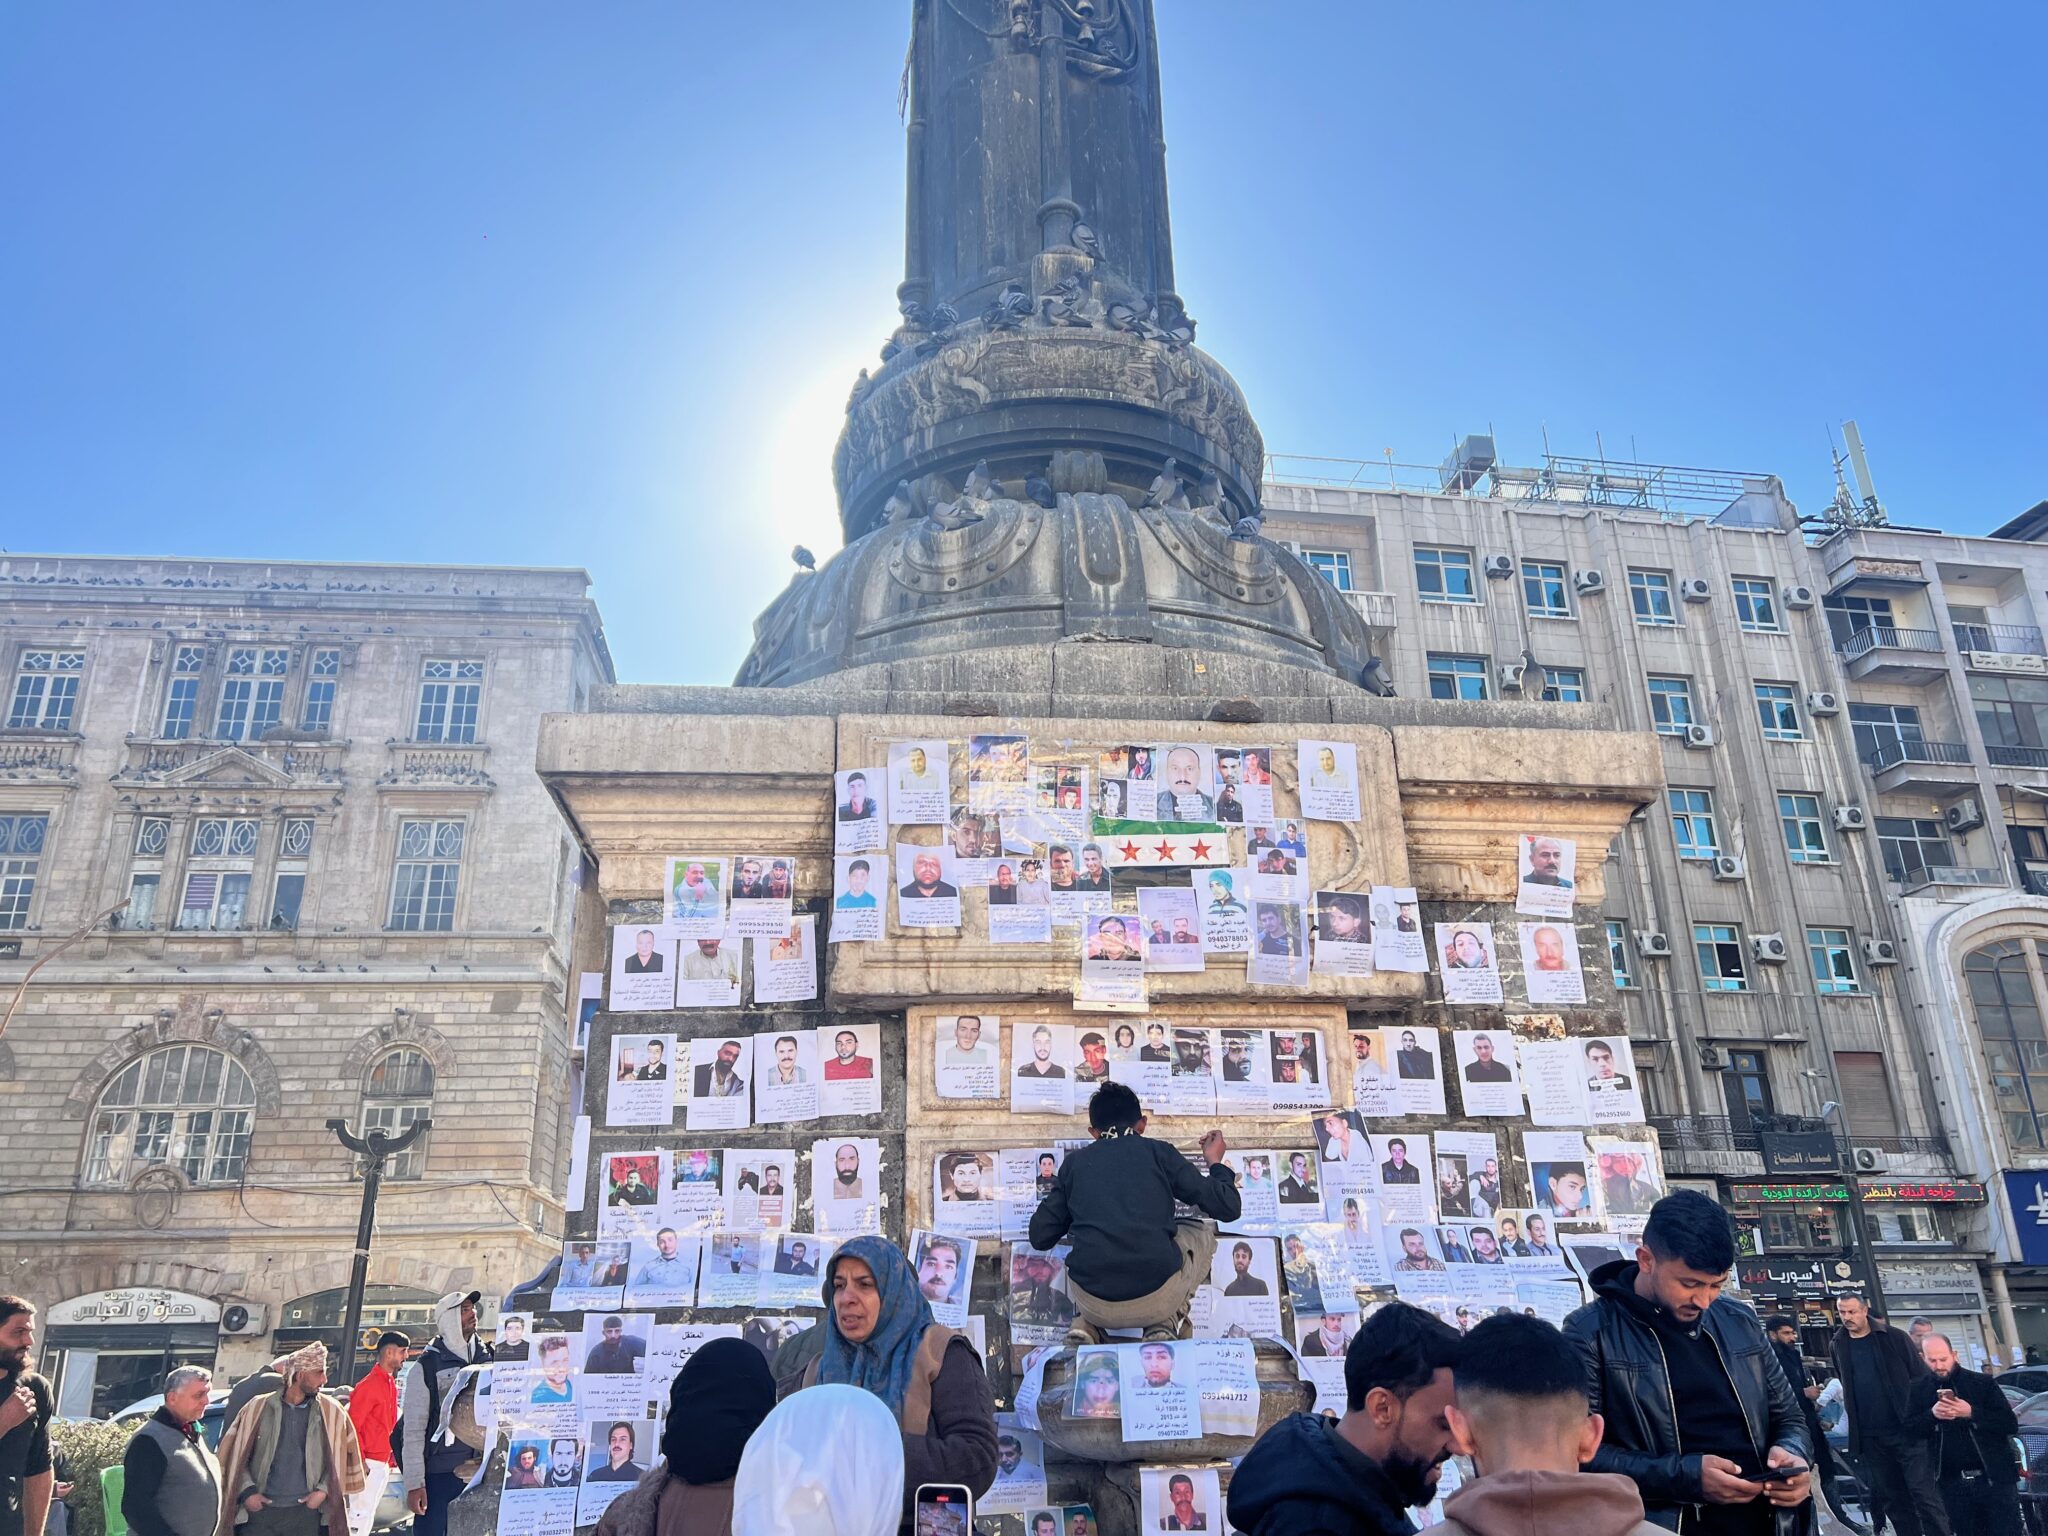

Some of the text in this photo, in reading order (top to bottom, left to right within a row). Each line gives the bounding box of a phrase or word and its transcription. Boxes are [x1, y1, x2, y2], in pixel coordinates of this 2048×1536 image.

[1768, 1269, 1813, 1284] سوريا
[73, 1300, 195, 1322] حمزة و العباس
[682, 1331, 704, 1340] المعتقل
[1202, 1392, 1248, 1401] 0991441712
